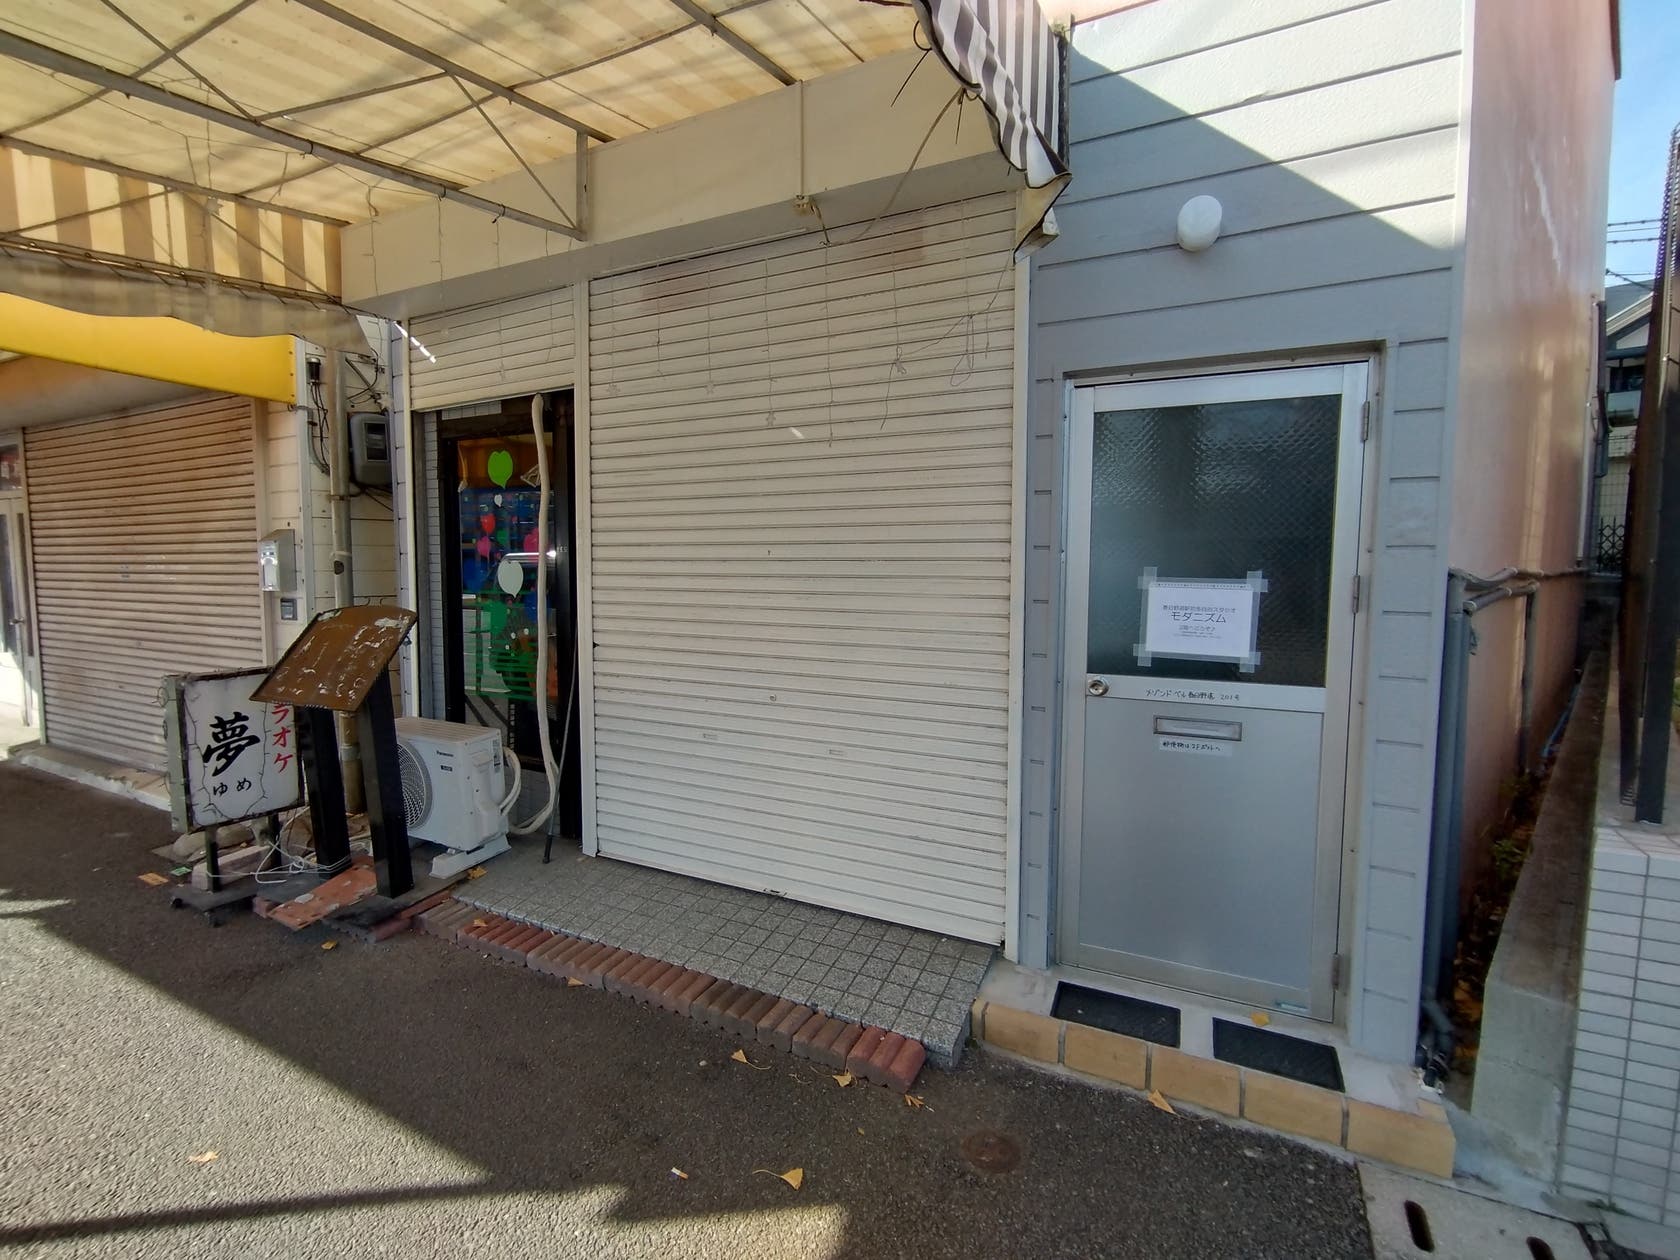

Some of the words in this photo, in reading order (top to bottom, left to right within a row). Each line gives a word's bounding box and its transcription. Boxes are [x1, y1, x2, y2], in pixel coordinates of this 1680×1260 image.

[1171, 611, 1227, 623] モダニズム
[202, 711, 261, 777] 夢
[212, 776, 253, 798] ゆめ
